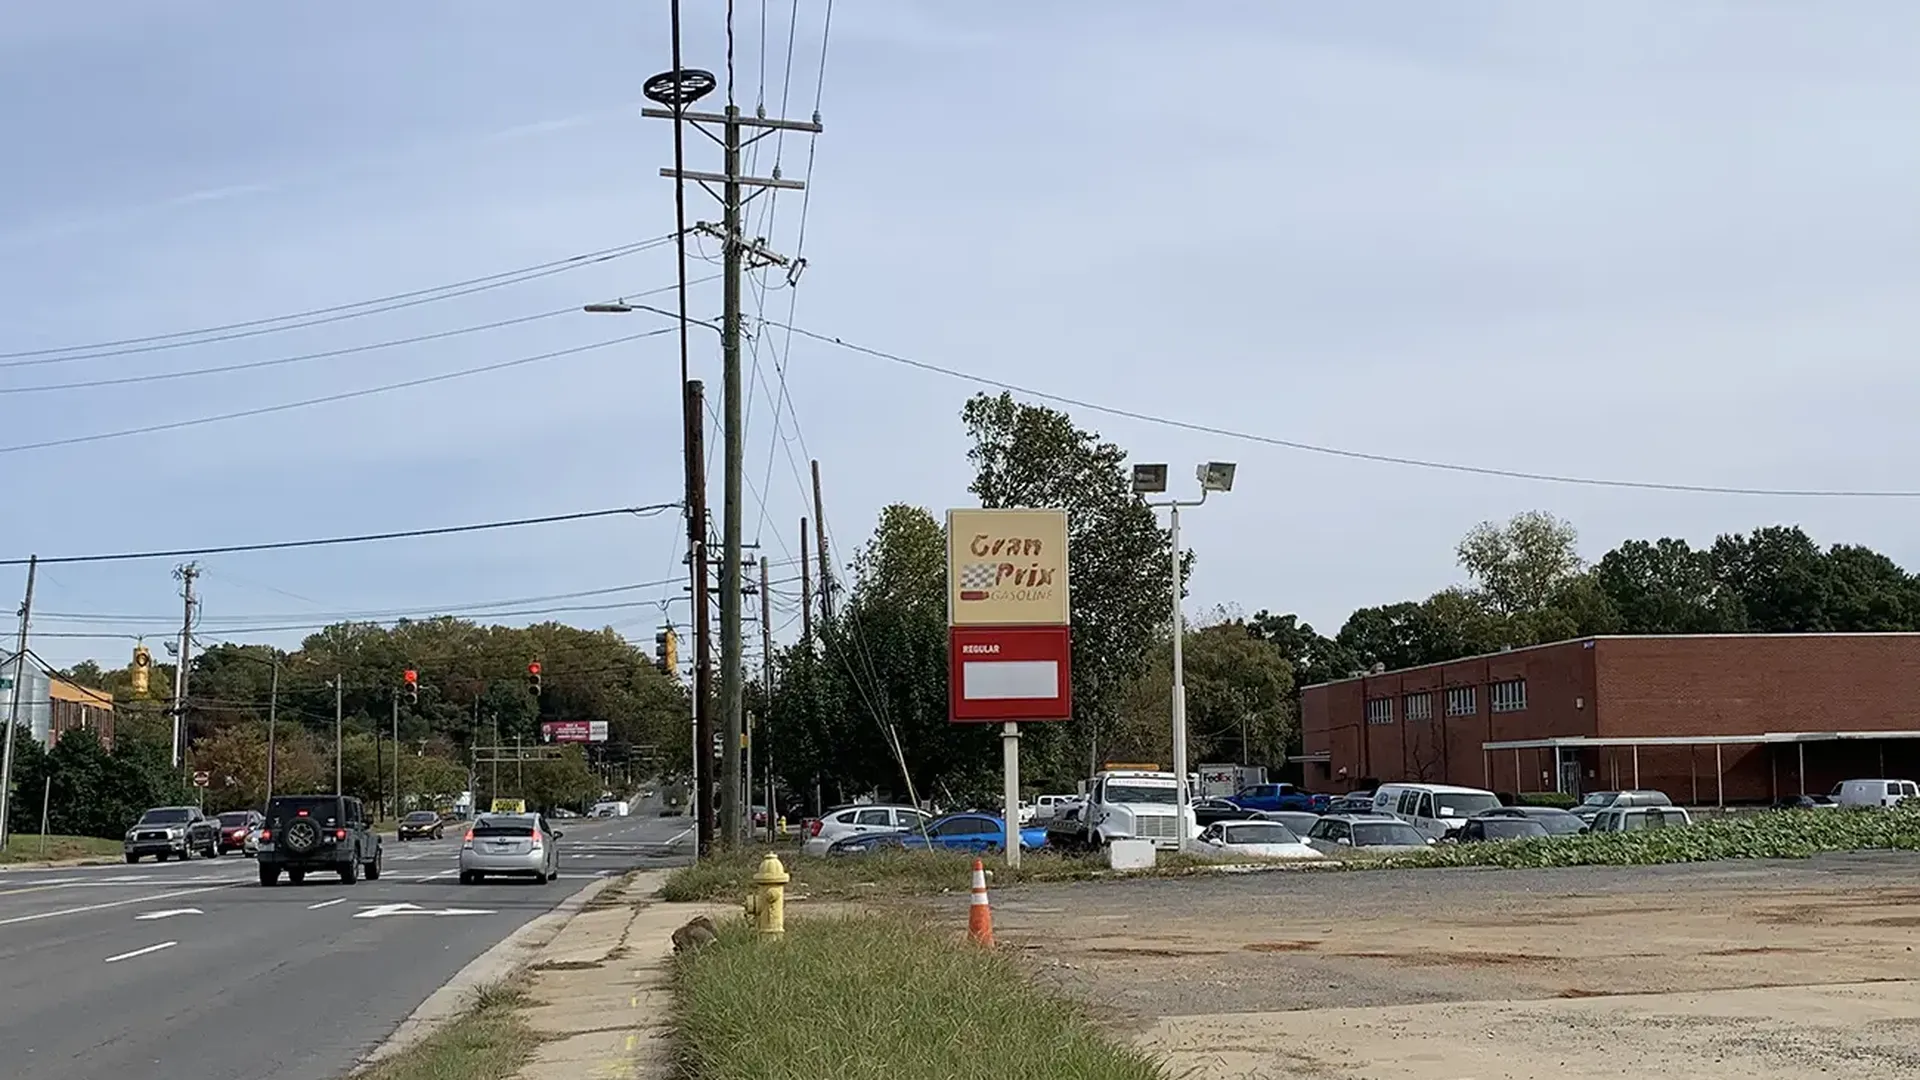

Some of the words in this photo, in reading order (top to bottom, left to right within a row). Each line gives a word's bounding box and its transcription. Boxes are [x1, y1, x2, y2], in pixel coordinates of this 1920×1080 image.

[970, 534, 1042, 557] Gran
[995, 562, 1056, 587] Prix
[991, 589, 1052, 601] GASOLINE
[962, 644, 1000, 654] REGULAR
[1203, 772, 1232, 783] FedEx
